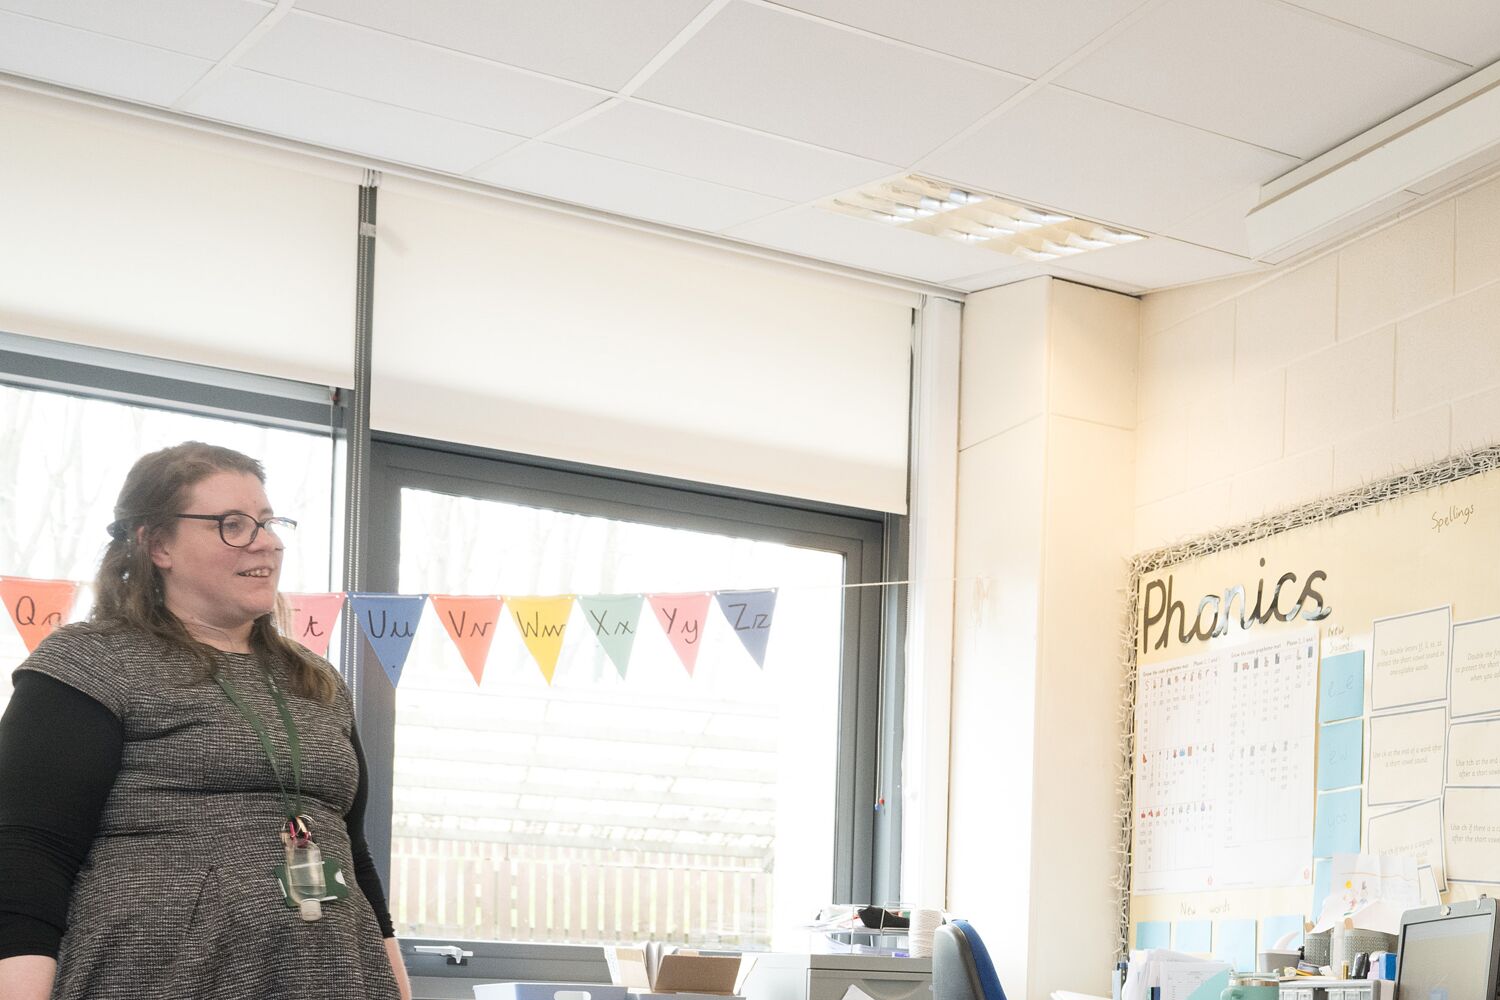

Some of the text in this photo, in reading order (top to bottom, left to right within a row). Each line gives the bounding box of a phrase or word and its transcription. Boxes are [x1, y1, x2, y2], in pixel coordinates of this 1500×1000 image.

[1432, 504, 1474, 533] Spellings
[1143, 558, 1332, 654] Phonics
[1461, 664, 1478, 673] protect
